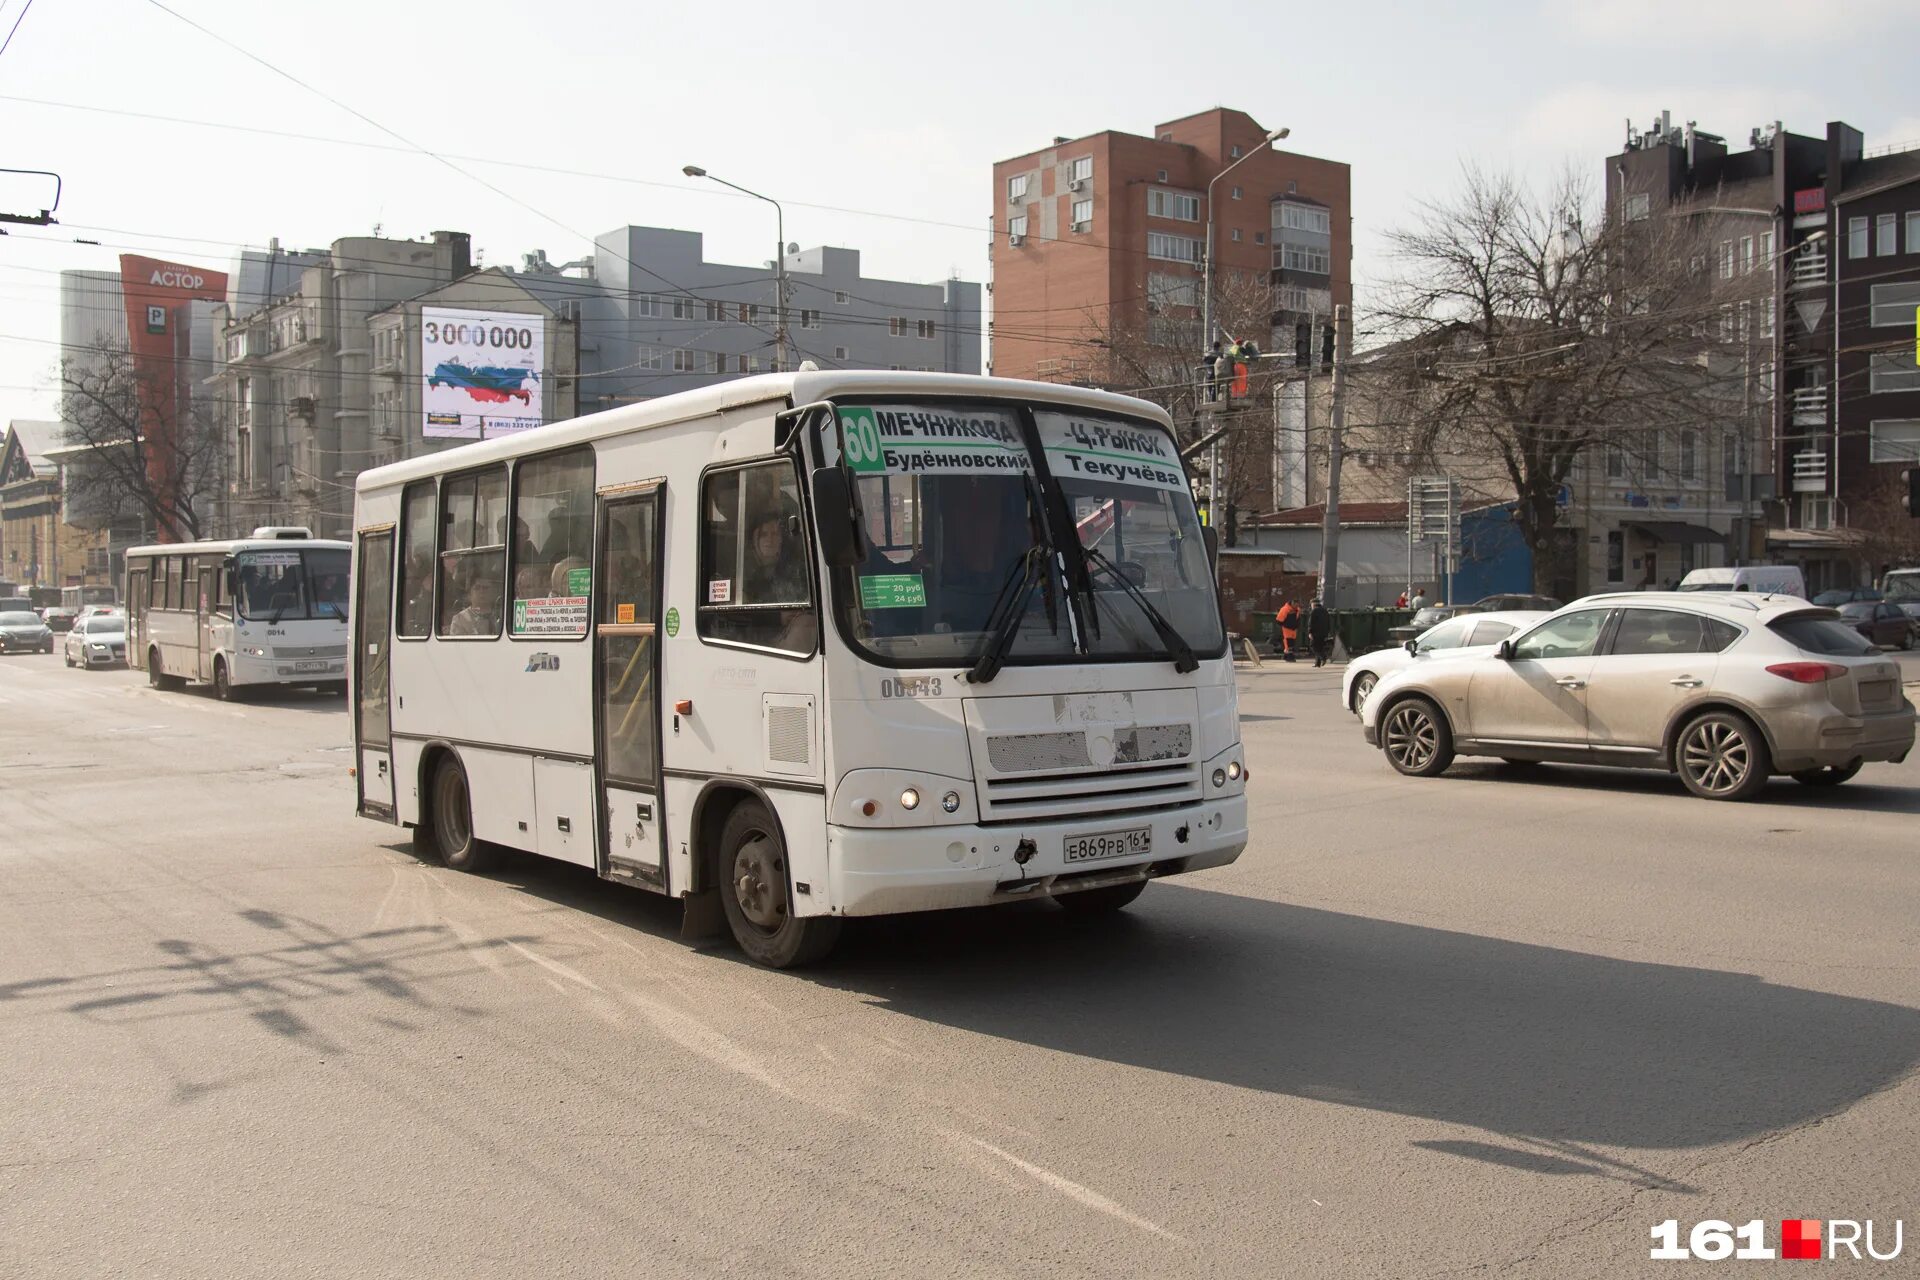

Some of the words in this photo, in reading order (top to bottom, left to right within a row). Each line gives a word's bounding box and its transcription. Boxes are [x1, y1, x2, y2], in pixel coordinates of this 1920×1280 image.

[150, 270, 204, 289] АСТОР
[425, 322, 439, 344] 3
[443, 323, 486, 347] 000
[490, 326, 532, 350] 000
[875, 411, 1018, 443] МЕЧНИКОВА
[842, 415, 879, 463] 60
[883, 450, 1031, 472] Будённовский
[1064, 454, 1180, 486] Текучёва
[893, 584, 904, 592] 20
[906, 584, 921, 593] руб
[907, 595, 922, 603] руб
[515, 605, 526, 628] 60
[1126, 831, 1146, 847] 161
